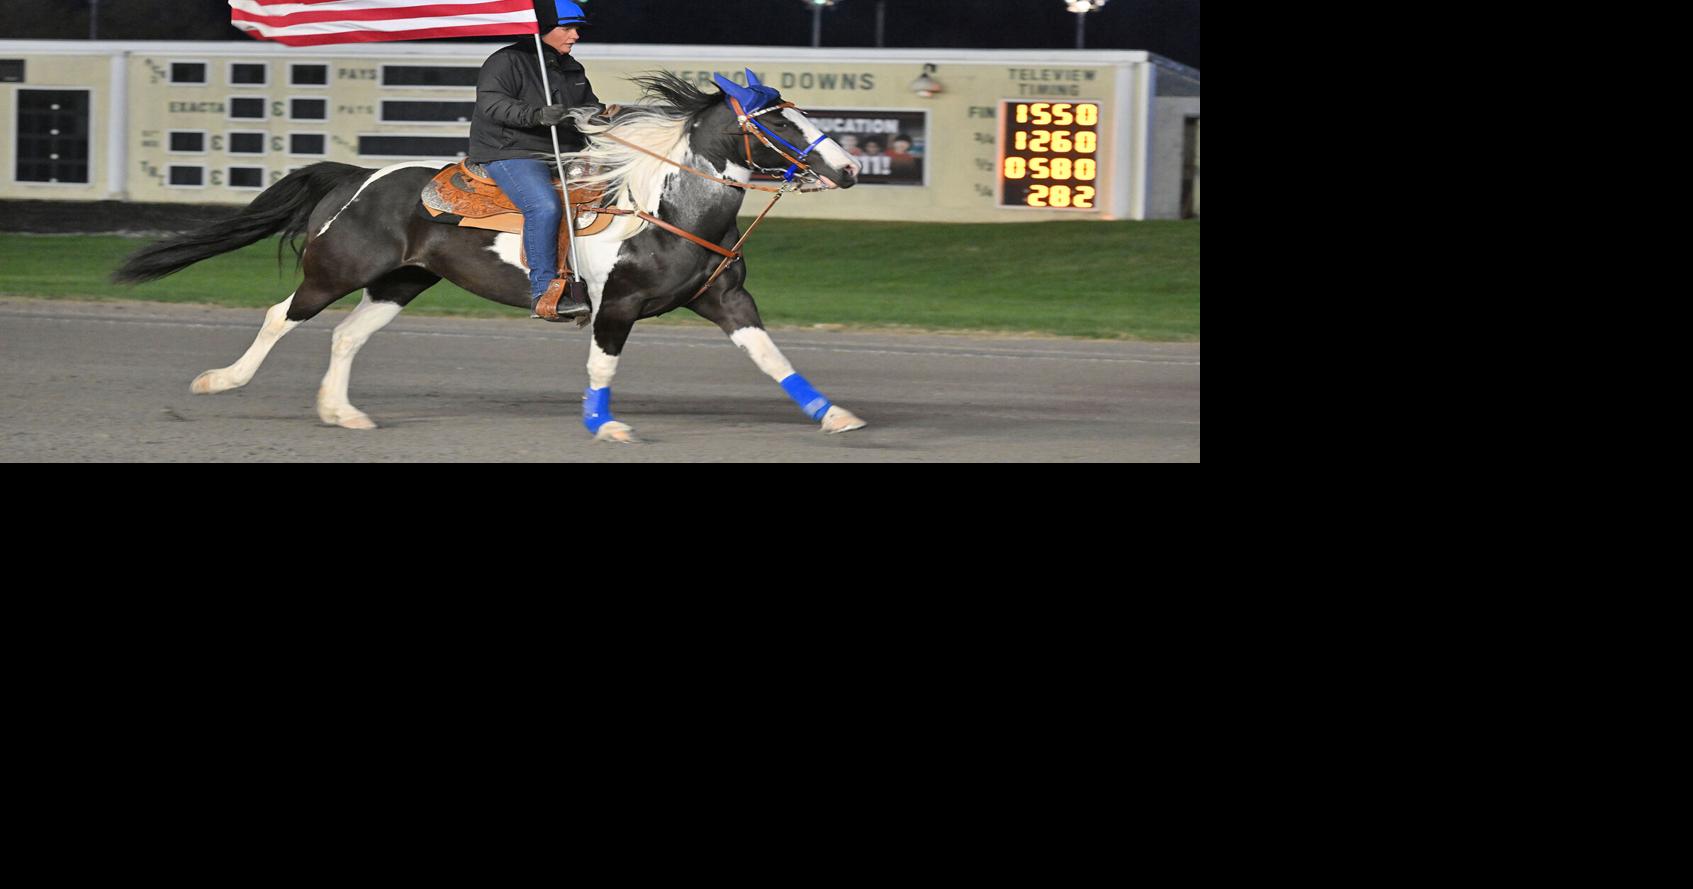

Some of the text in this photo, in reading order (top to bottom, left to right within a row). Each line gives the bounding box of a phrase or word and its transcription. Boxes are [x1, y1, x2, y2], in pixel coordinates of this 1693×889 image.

[338, 68, 377, 80] PAYS
[782, 72, 875, 90] DOWNS
[1008, 68, 1096, 81] TELEVIEW
[1019, 83, 1080, 96] TIMING
[169, 102, 225, 113] EXACTA
[1016, 103, 1098, 126] 1550
[1015, 130, 1097, 153] 1260
[1004, 157, 1097, 180] 0580
[1027, 184, 1096, 208] 282
